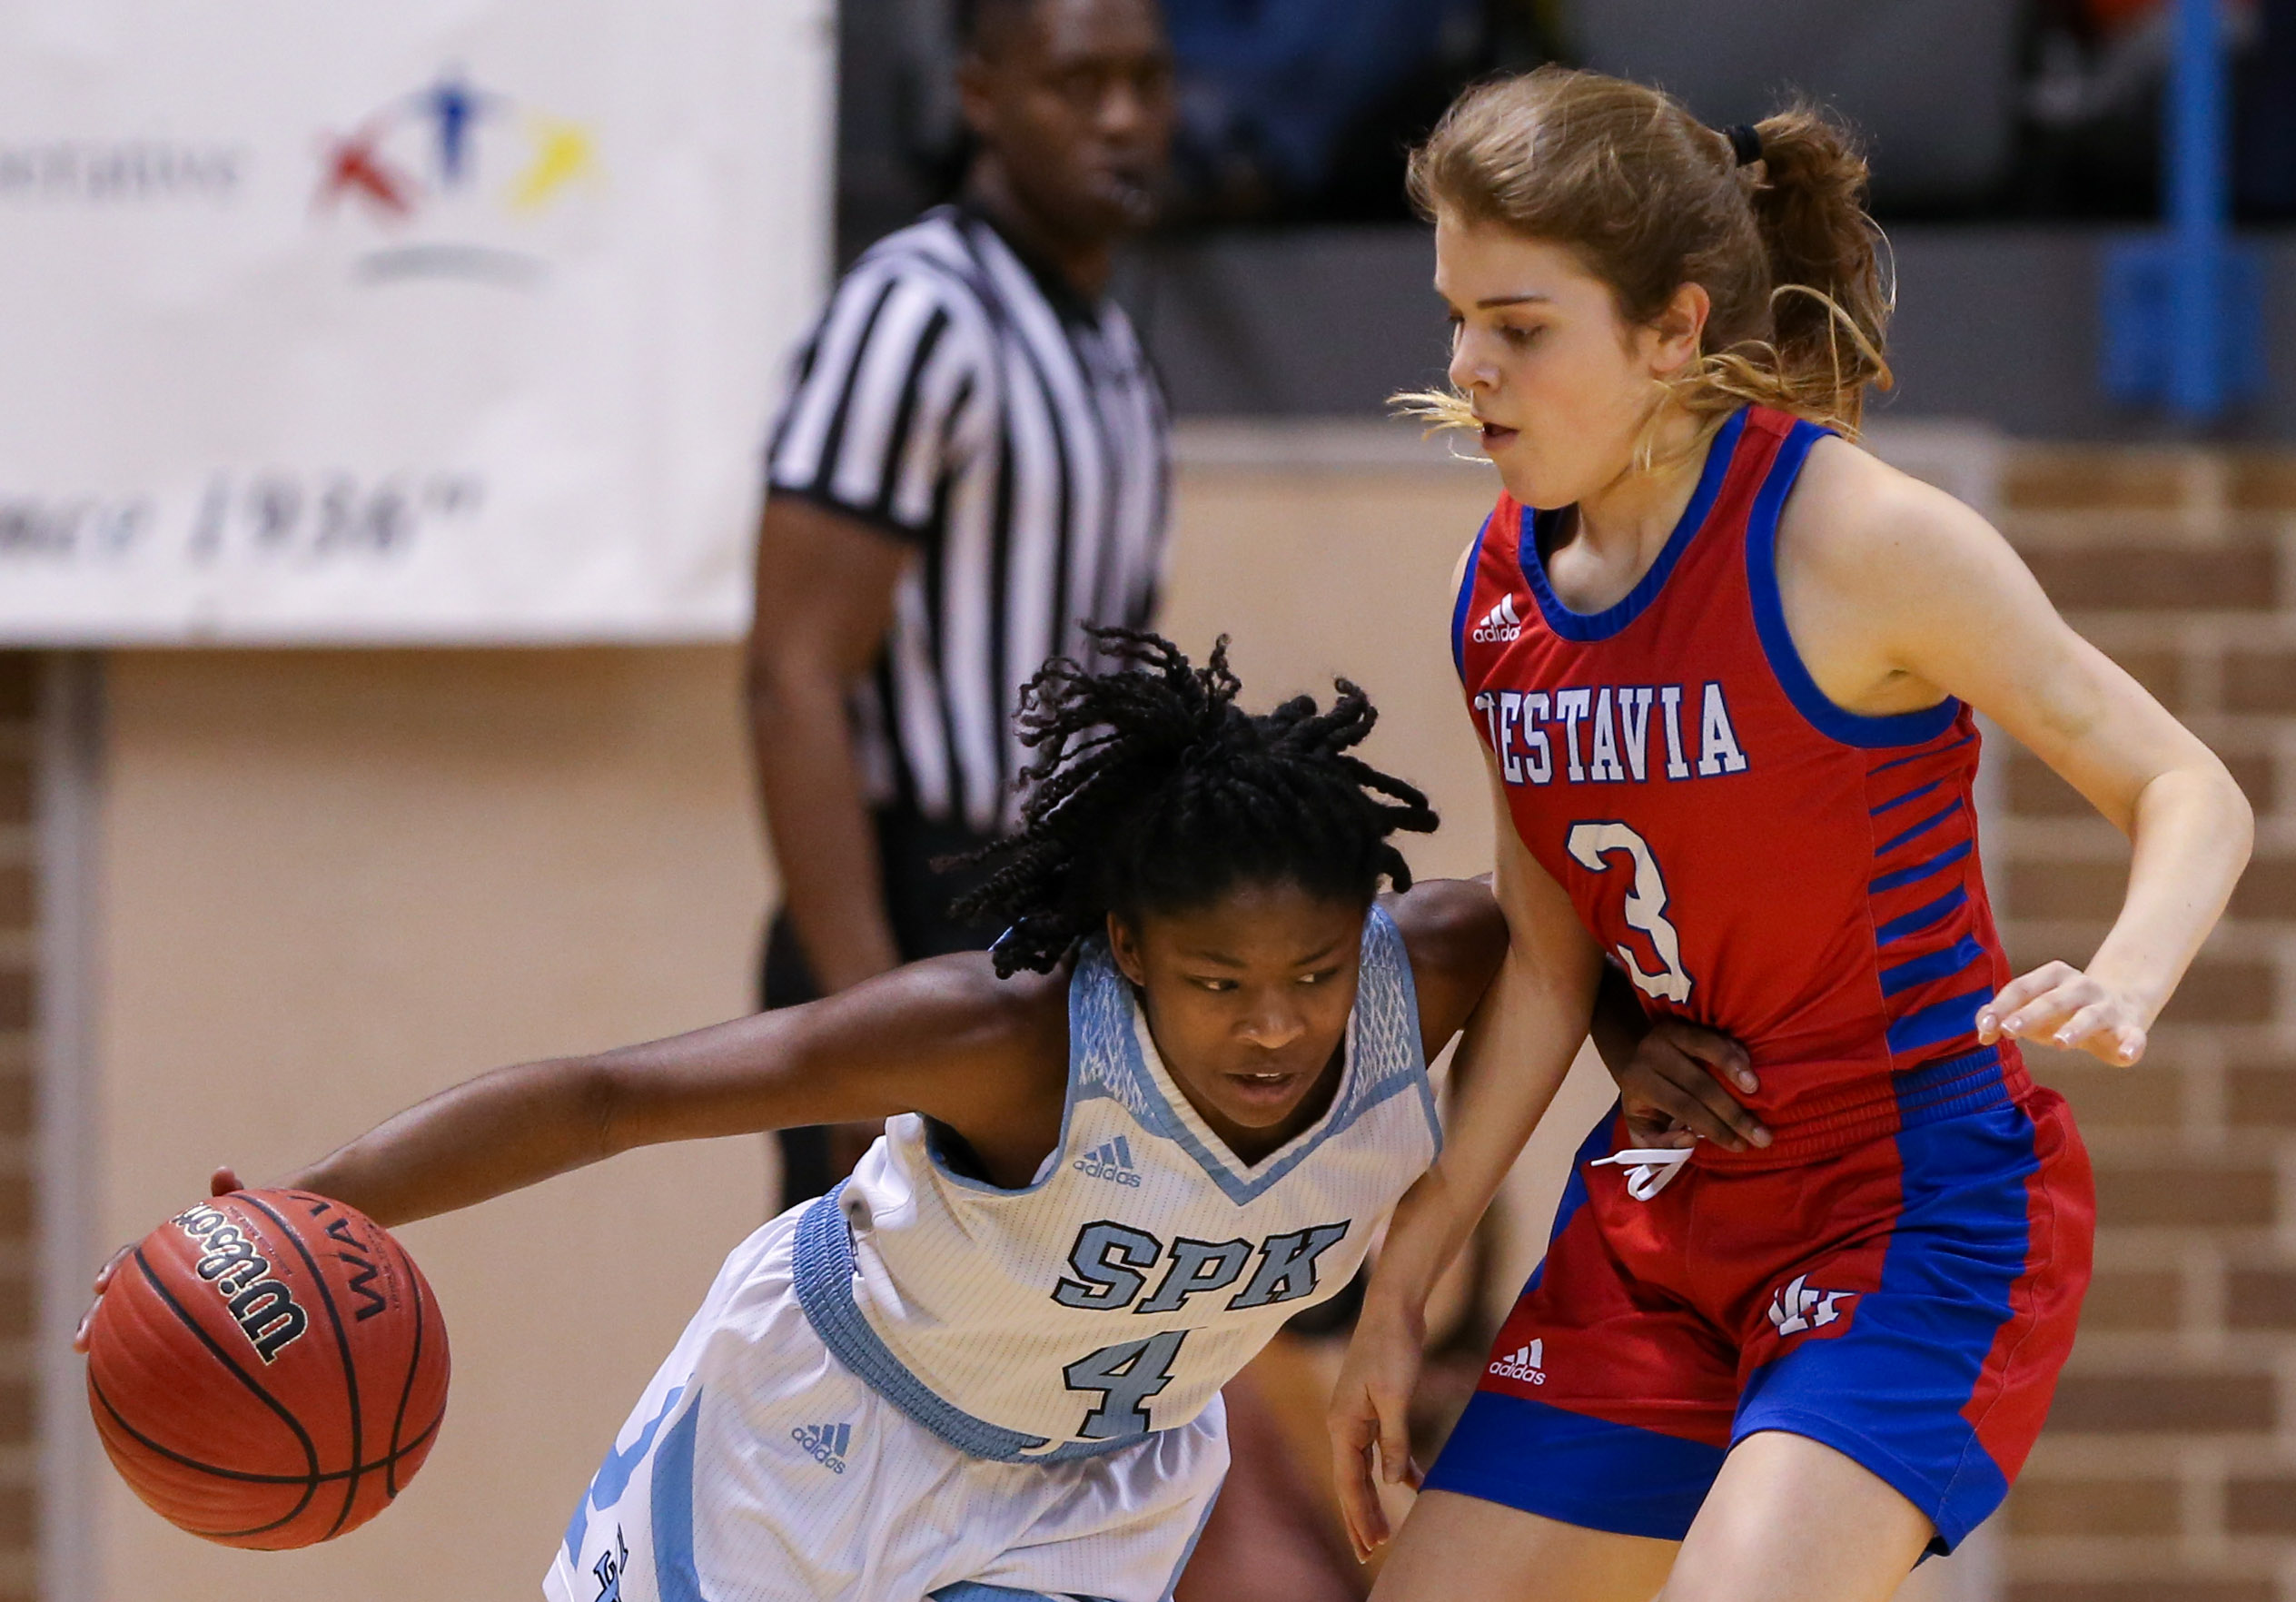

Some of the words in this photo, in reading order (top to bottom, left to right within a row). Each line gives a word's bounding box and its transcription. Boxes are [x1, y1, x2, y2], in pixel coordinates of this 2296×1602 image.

[1472, 624, 1521, 643] adida
[1567, 820, 1693, 1005] 3
[1073, 1158, 1142, 1188] adidas
[1050, 1219, 1352, 1315] SPK
[1062, 1326, 1192, 1439] 4
[1489, 1360, 1546, 1386] adidas
[791, 1427, 847, 1475] adidas
